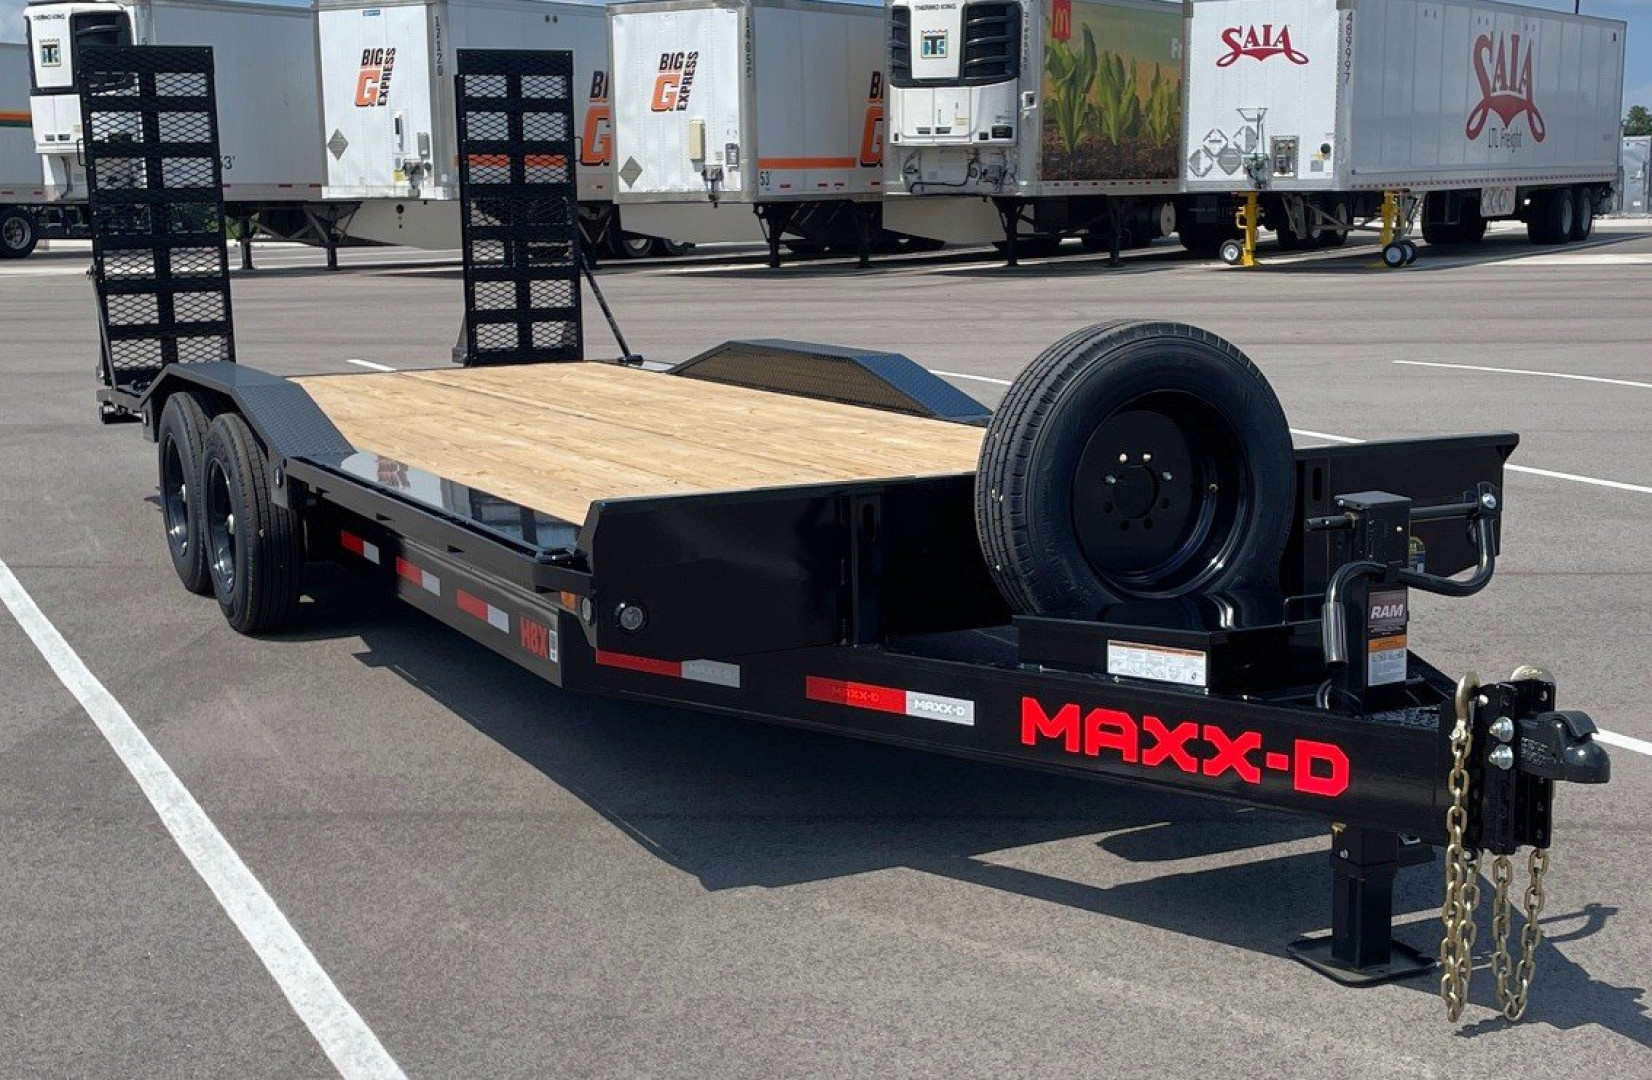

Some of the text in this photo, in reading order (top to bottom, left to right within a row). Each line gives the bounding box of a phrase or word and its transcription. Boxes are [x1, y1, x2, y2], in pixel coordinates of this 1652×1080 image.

[361, 48, 384, 67] BIG
[659, 52, 685, 71] BIG
[1216, 24, 1309, 68] SAIA
[355, 69, 380, 107] G
[377, 47, 396, 106] EXPRESS
[590, 70, 609, 98] BI
[651, 74, 681, 112] G
[676, 51, 699, 111] EXPRESS
[1370, 604, 1404, 620] RAM
[913, 699, 966, 717] MAXX-D
[1020, 696, 1350, 798] MAXX-D
